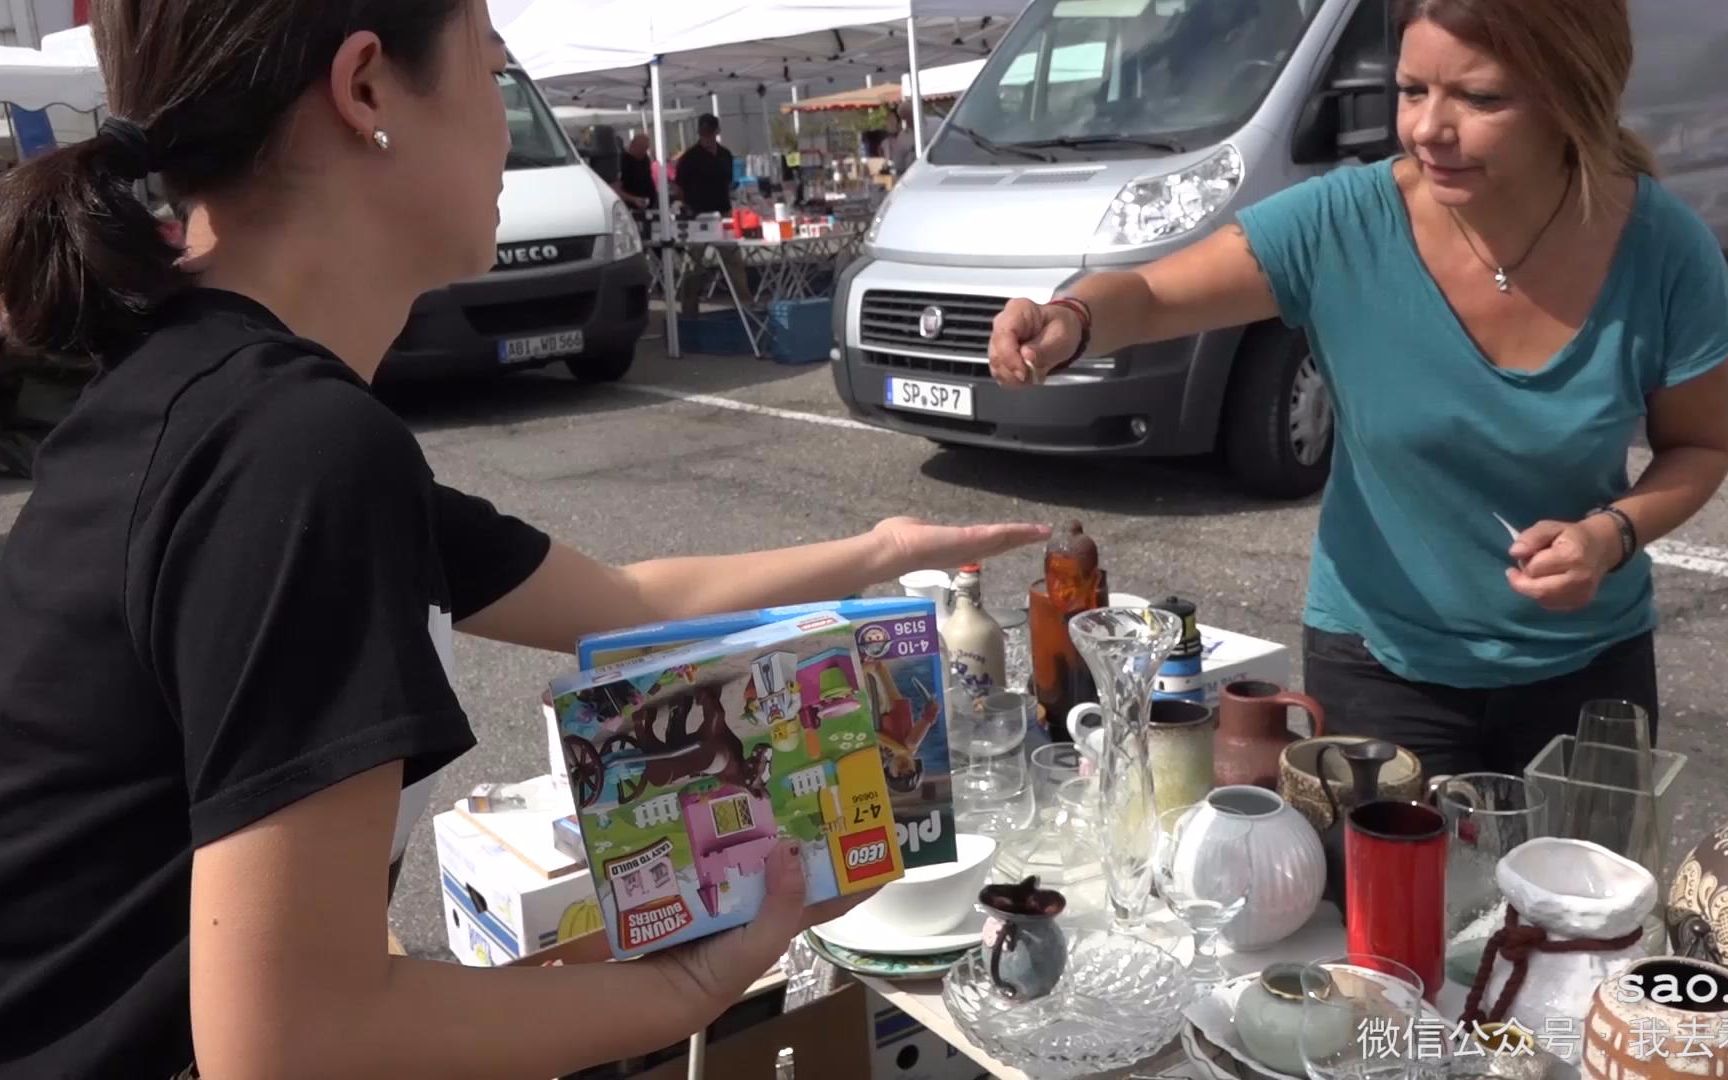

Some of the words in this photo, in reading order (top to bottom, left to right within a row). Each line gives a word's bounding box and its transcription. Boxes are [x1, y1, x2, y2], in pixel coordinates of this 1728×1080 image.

[498, 245, 558, 265] VECO
[894, 620, 927, 636] 5136
[897, 639, 930, 656] 4-10
[853, 803, 882, 824] 4-7
[652, 842, 671, 857] EASY
[846, 841, 887, 868] LEGO
[611, 861, 640, 876] BUILD
[640, 854, 652, 865] TO
[628, 902, 684, 928] BUILDERS
[629, 912, 689, 945] YOUNG
